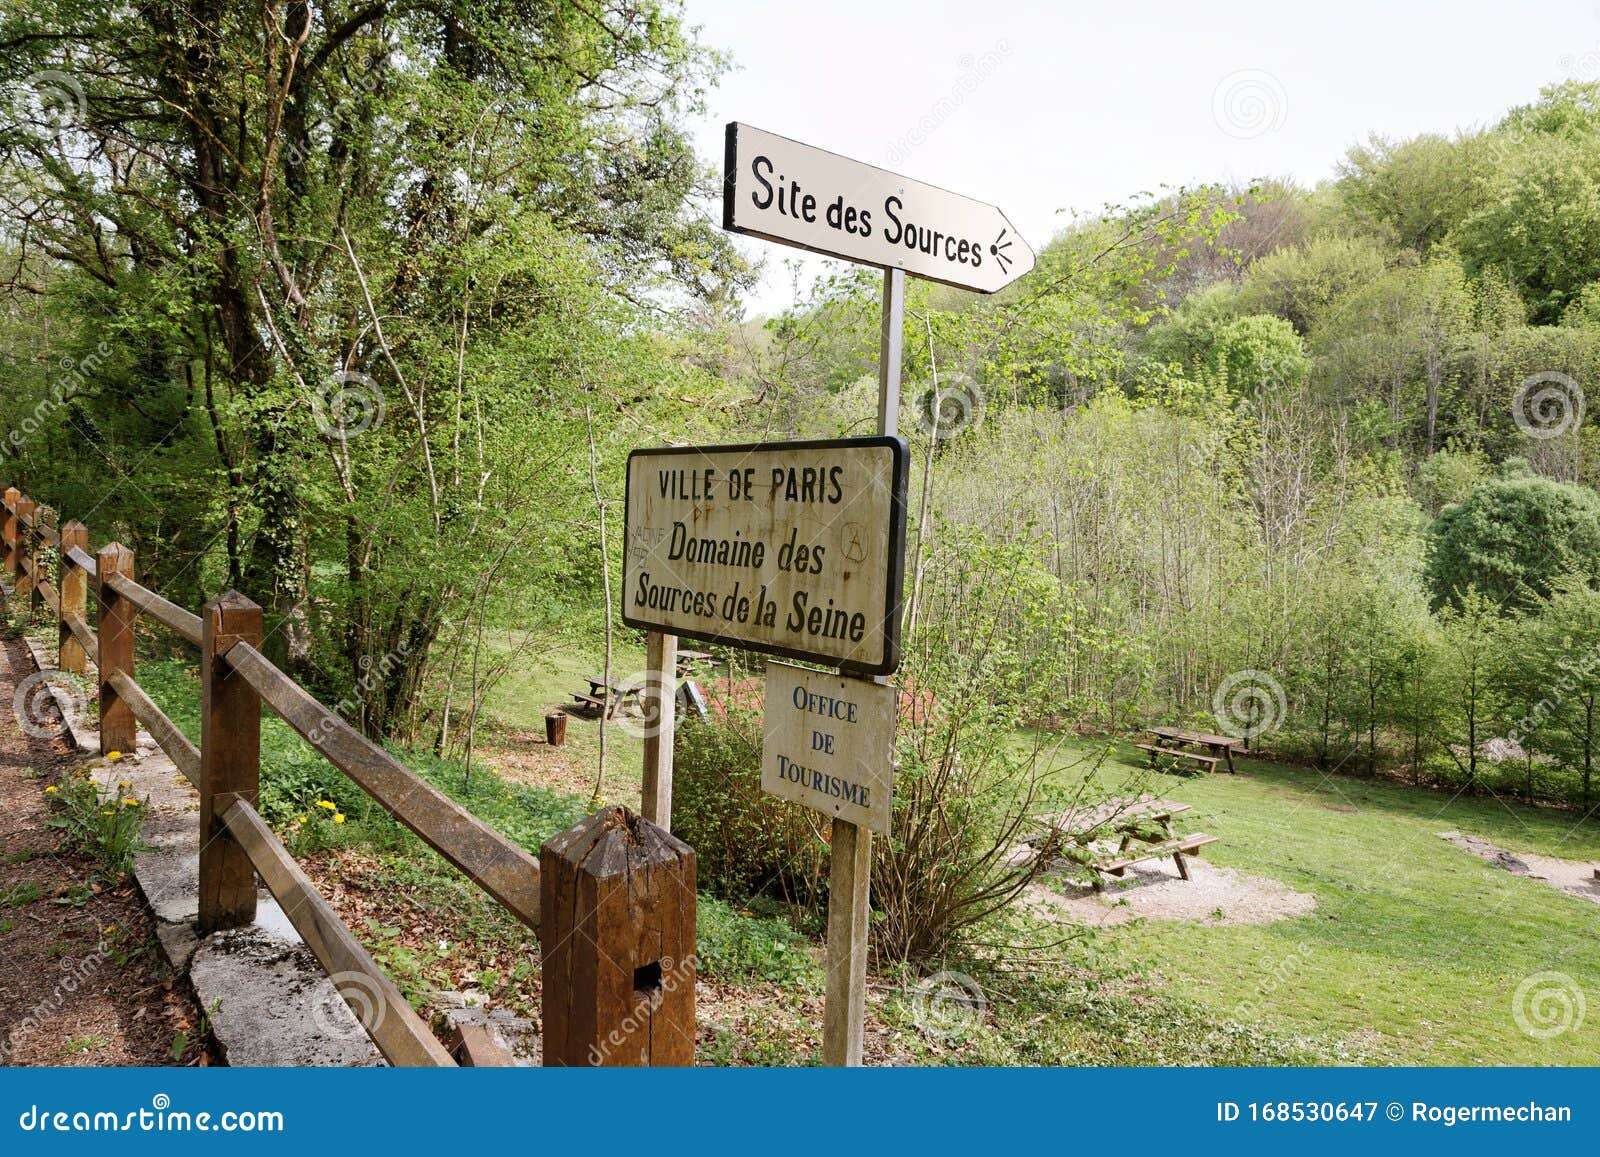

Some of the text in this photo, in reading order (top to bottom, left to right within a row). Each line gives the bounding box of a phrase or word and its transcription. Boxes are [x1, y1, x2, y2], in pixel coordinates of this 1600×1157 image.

[752, 155, 982, 268] Site des Sources
[659, 466, 844, 504] VILLE DE PARIS
[668, 521, 765, 569] Domaine
[778, 528, 826, 575] des
[634, 572, 866, 643] Sources de la Seine
[792, 686, 858, 723] OFFICE
[811, 731, 835, 755] DE
[776, 754, 871, 808] TOURISME
